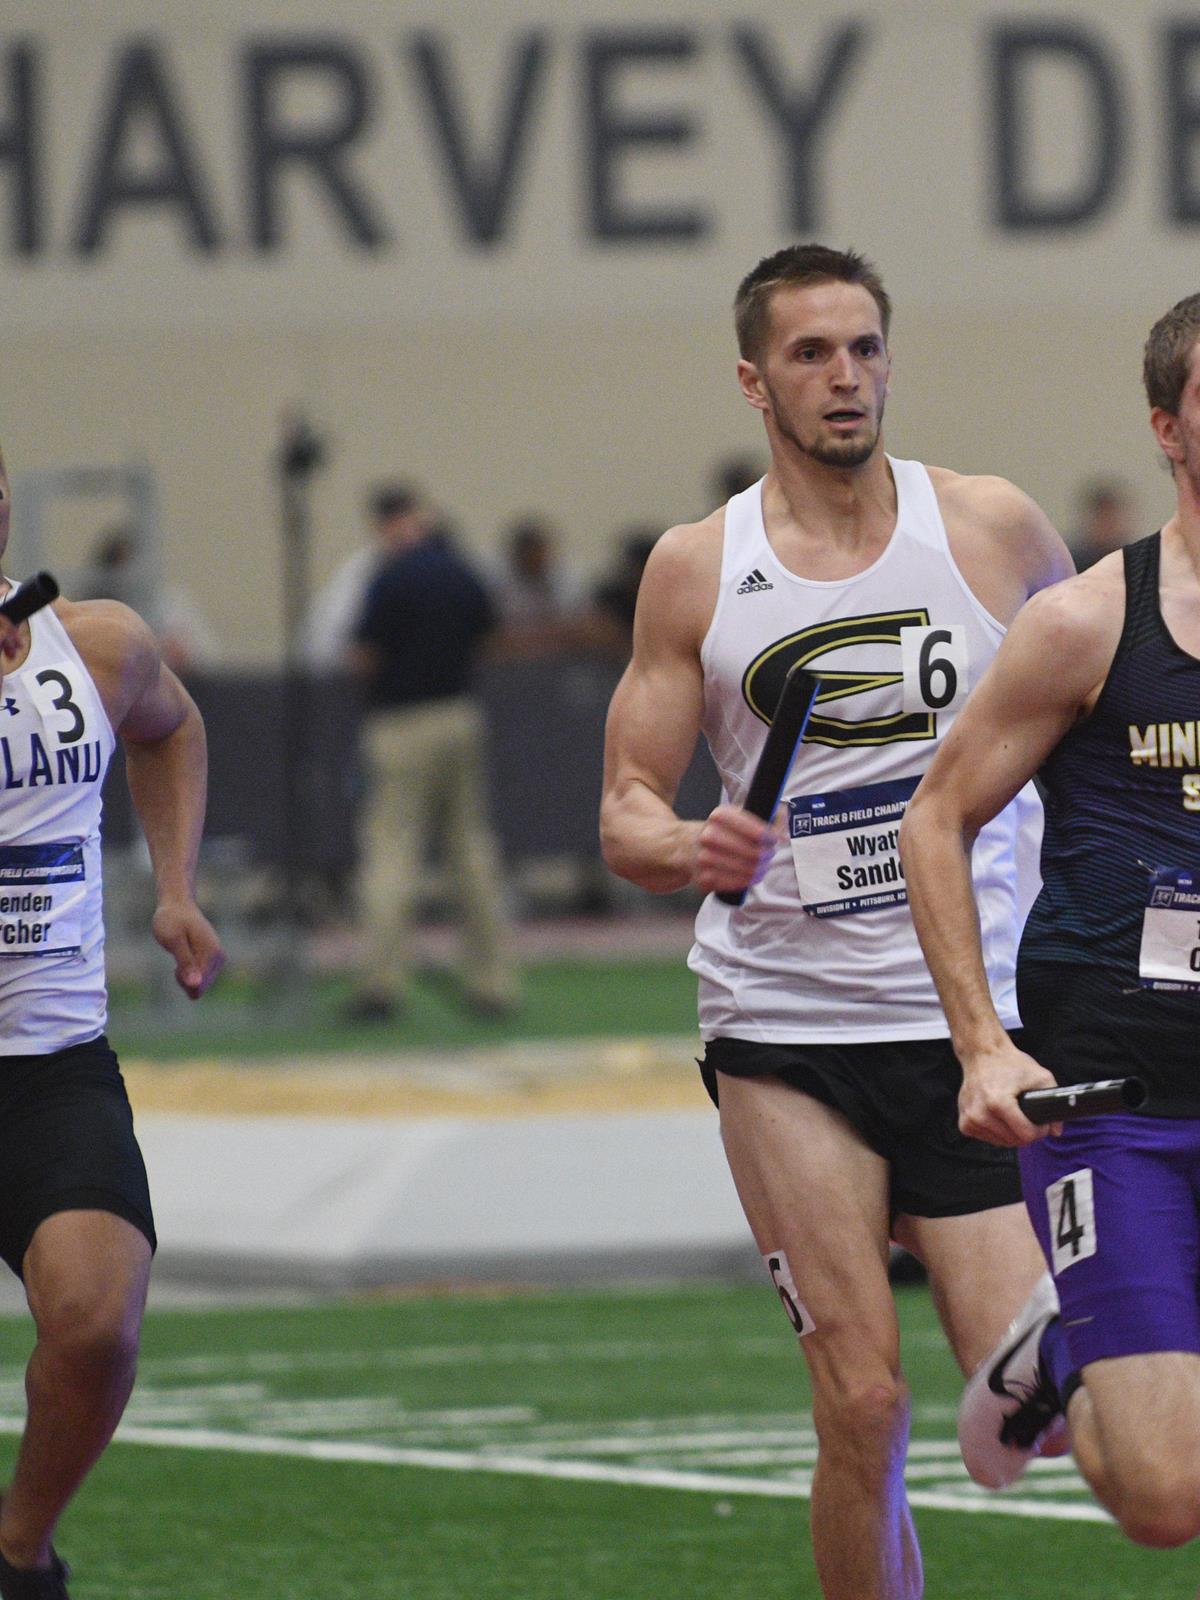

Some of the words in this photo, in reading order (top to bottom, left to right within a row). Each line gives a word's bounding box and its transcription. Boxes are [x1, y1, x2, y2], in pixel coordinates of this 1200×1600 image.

[736, 582, 774, 595] adidas
[918, 629, 958, 710] 6
[35, 669, 85, 744] 3
[0, 732, 101, 790] LAND
[812, 814, 841, 828] TRACK
[849, 807, 873, 822] FIELD
[0, 919, 51, 945] cher
[1056, 1179, 1085, 1258] 4
